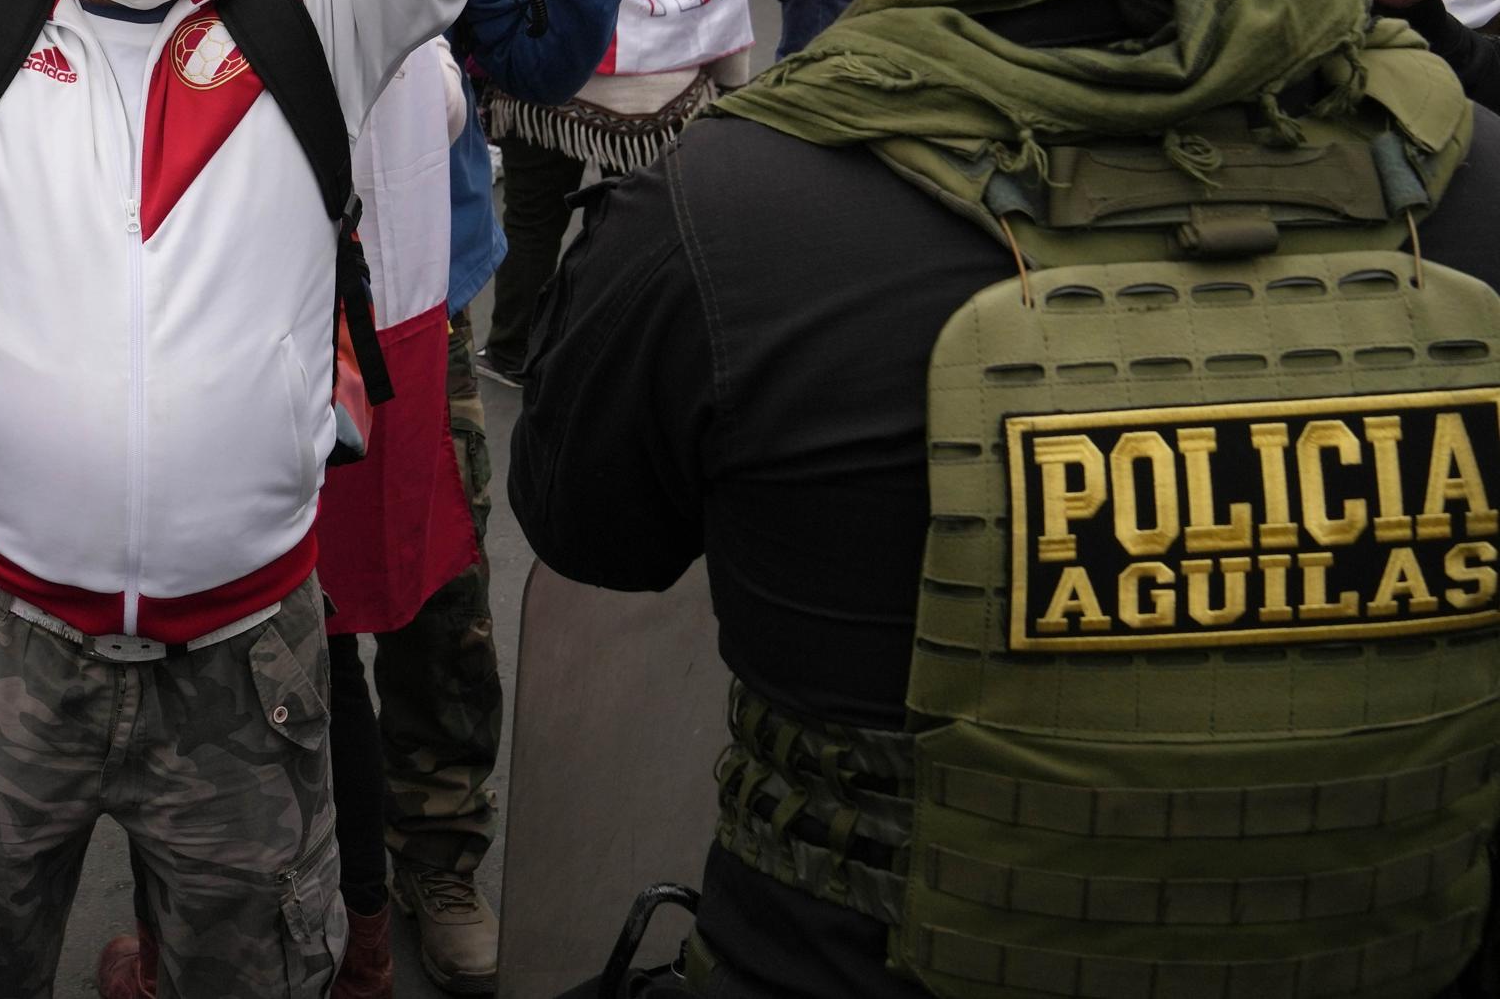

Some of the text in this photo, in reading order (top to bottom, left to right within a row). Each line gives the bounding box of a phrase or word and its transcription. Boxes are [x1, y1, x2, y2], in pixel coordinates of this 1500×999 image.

[21, 59, 78, 83] adidas
[1033, 412, 1500, 562] POLICIA
[1036, 541, 1500, 632] AGUILAS
